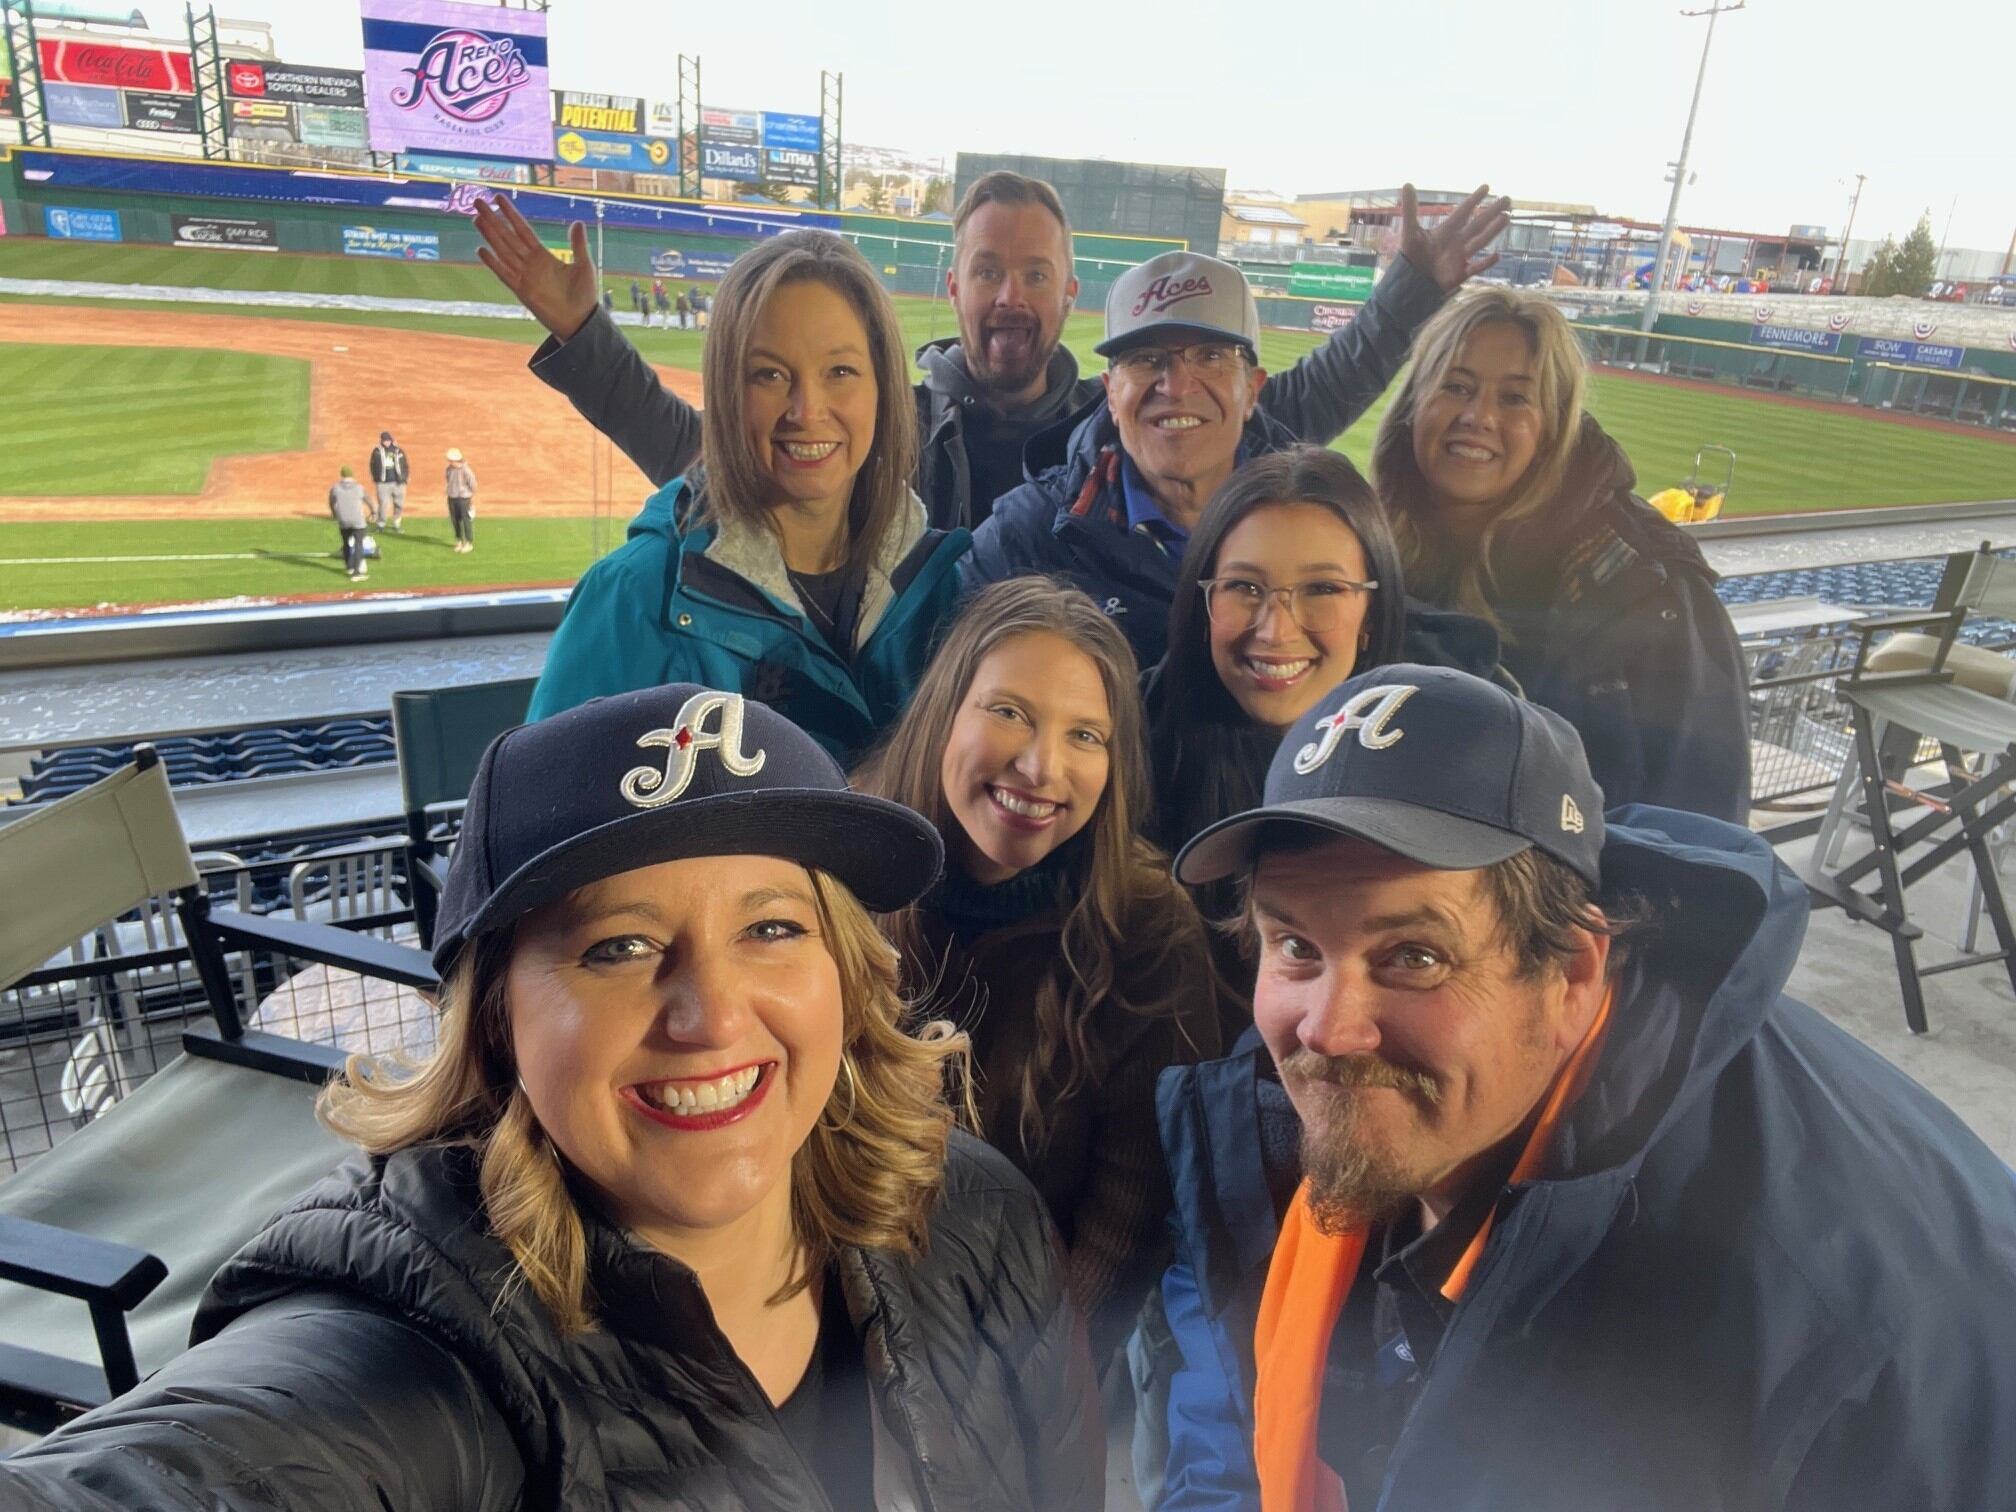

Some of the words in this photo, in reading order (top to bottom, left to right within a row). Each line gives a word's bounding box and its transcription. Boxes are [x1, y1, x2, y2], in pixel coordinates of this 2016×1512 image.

[459, 38, 512, 65] RENO
[265, 72, 317, 85] NORTHERN
[319, 76, 360, 89] NEVADA
[389, 39, 529, 112] Aces
[267, 82, 304, 94] TOYOTA
[305, 85, 348, 98] DEALERS
[560, 104, 638, 133] POTENTIAL
[704, 148, 757, 169] Dillard's
[1132, 275, 1213, 317] Aces
[1917, 345, 1954, 358] CAESARS
[1294, 684, 1421, 775] A
[620, 691, 767, 809] A
